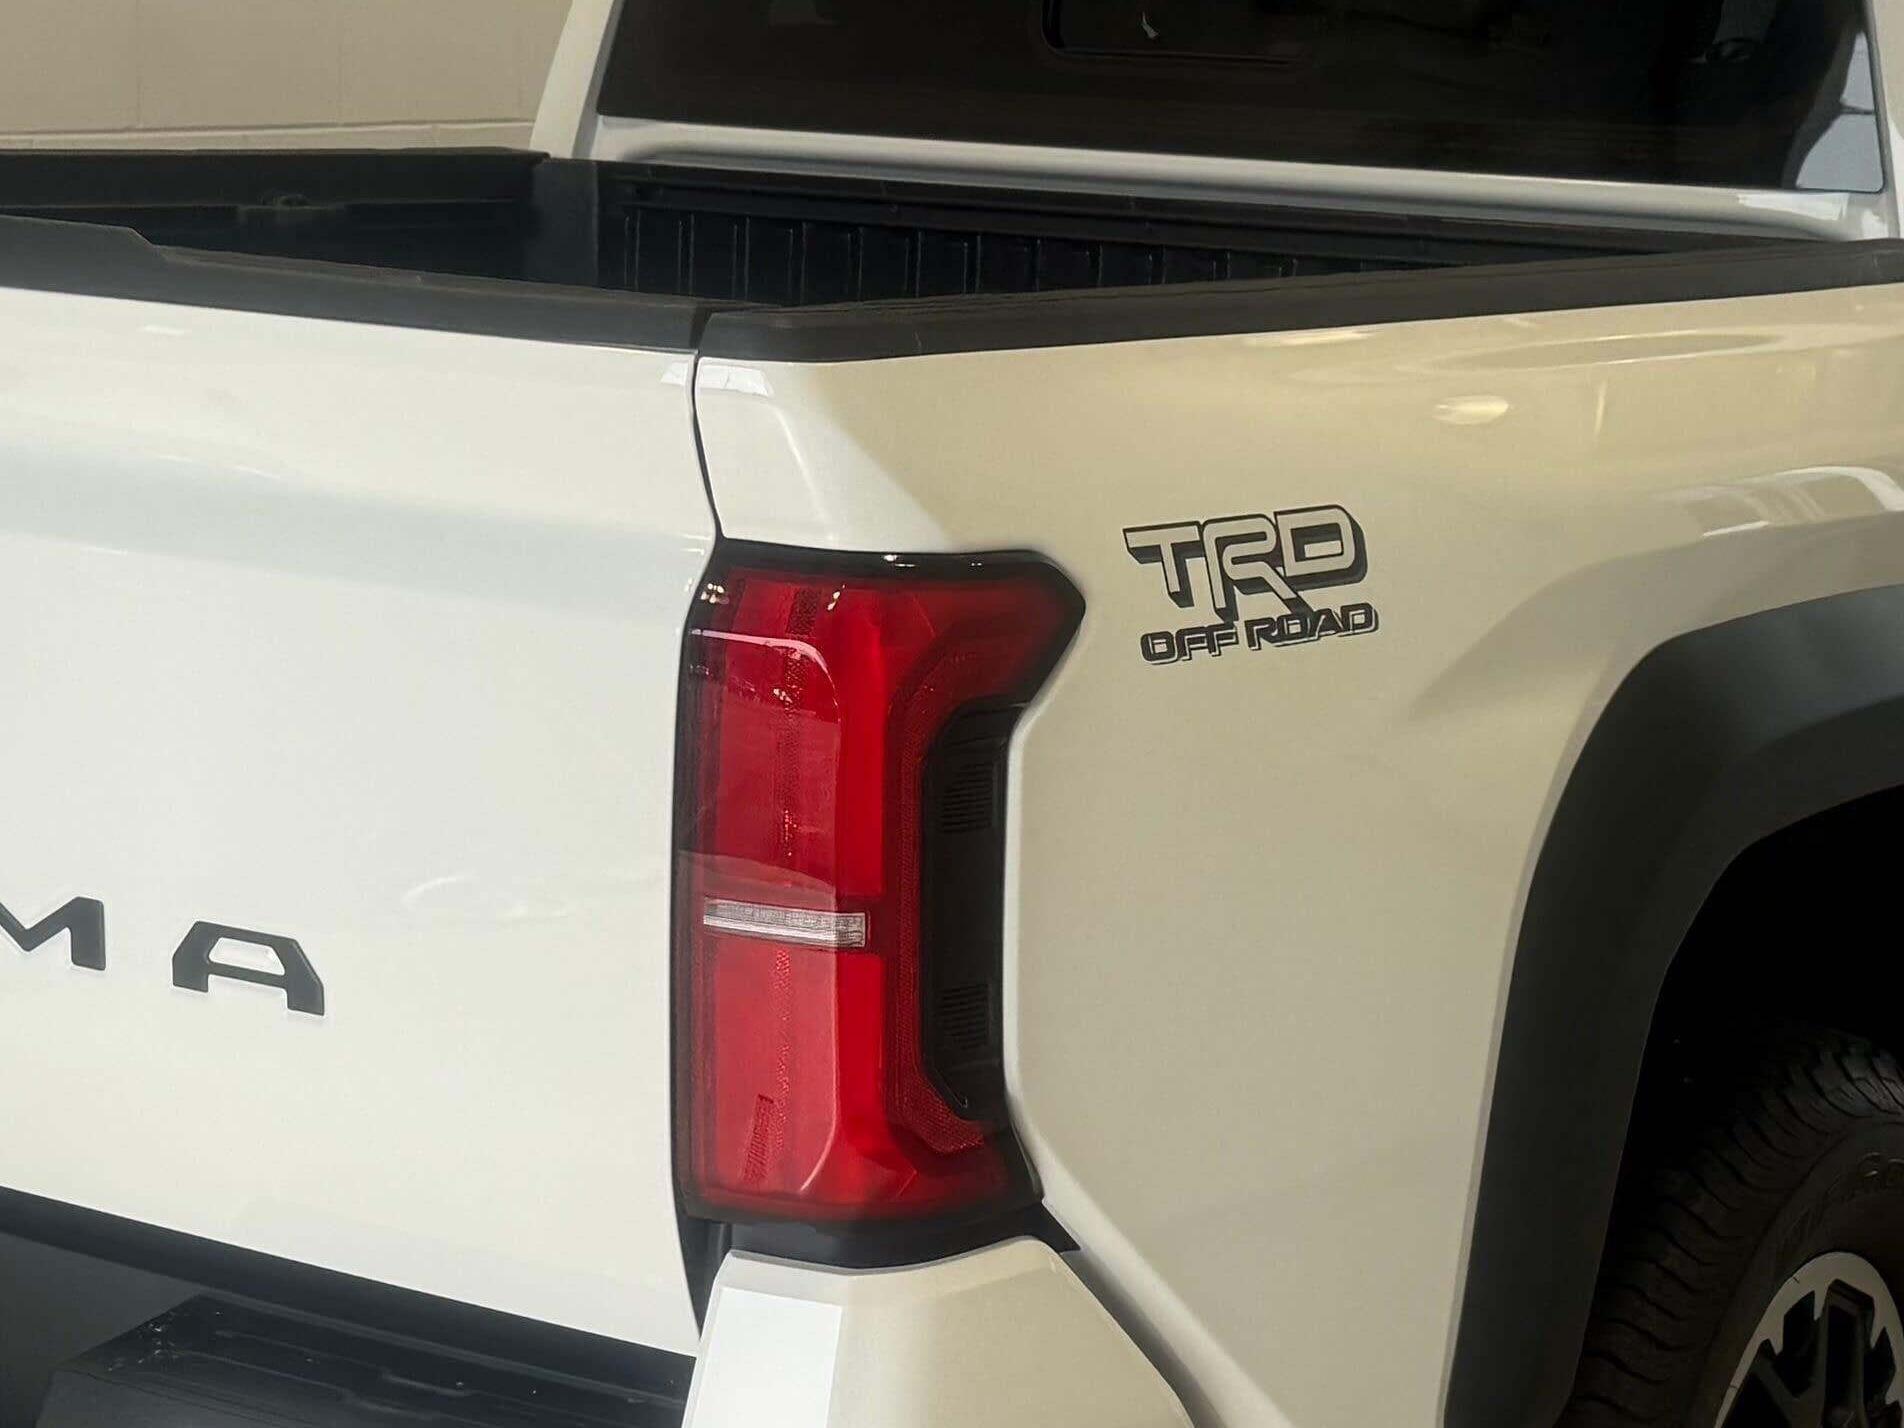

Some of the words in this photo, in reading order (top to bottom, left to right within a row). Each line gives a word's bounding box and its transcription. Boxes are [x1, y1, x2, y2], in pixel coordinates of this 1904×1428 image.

[1122, 504, 1368, 622] TRD
[1140, 625, 1239, 665] OFF
[1245, 603, 1379, 651] ROAD
